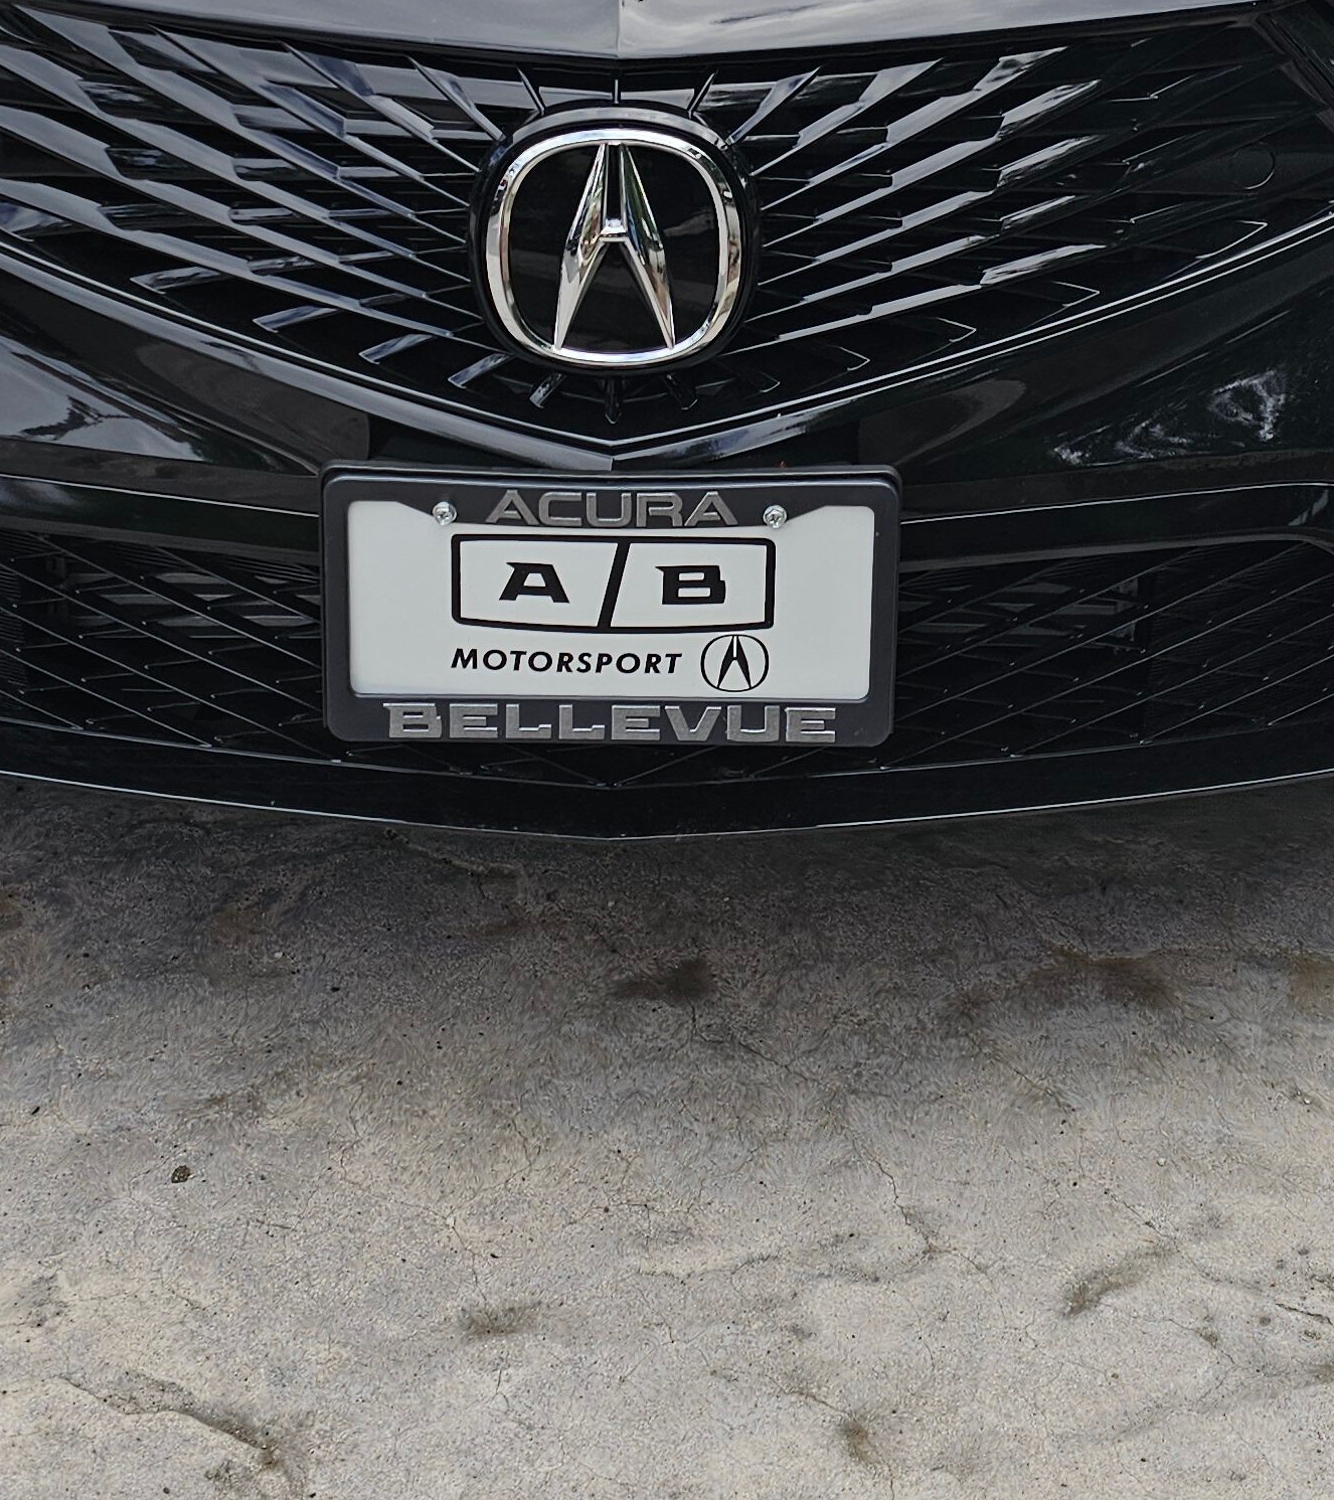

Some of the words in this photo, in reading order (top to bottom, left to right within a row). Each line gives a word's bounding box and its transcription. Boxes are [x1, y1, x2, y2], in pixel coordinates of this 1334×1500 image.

[484, 489, 739, 529] ACURA
[451, 647, 684, 675] MOTORSPORT
[383, 701, 838, 744] BELLEVUE
